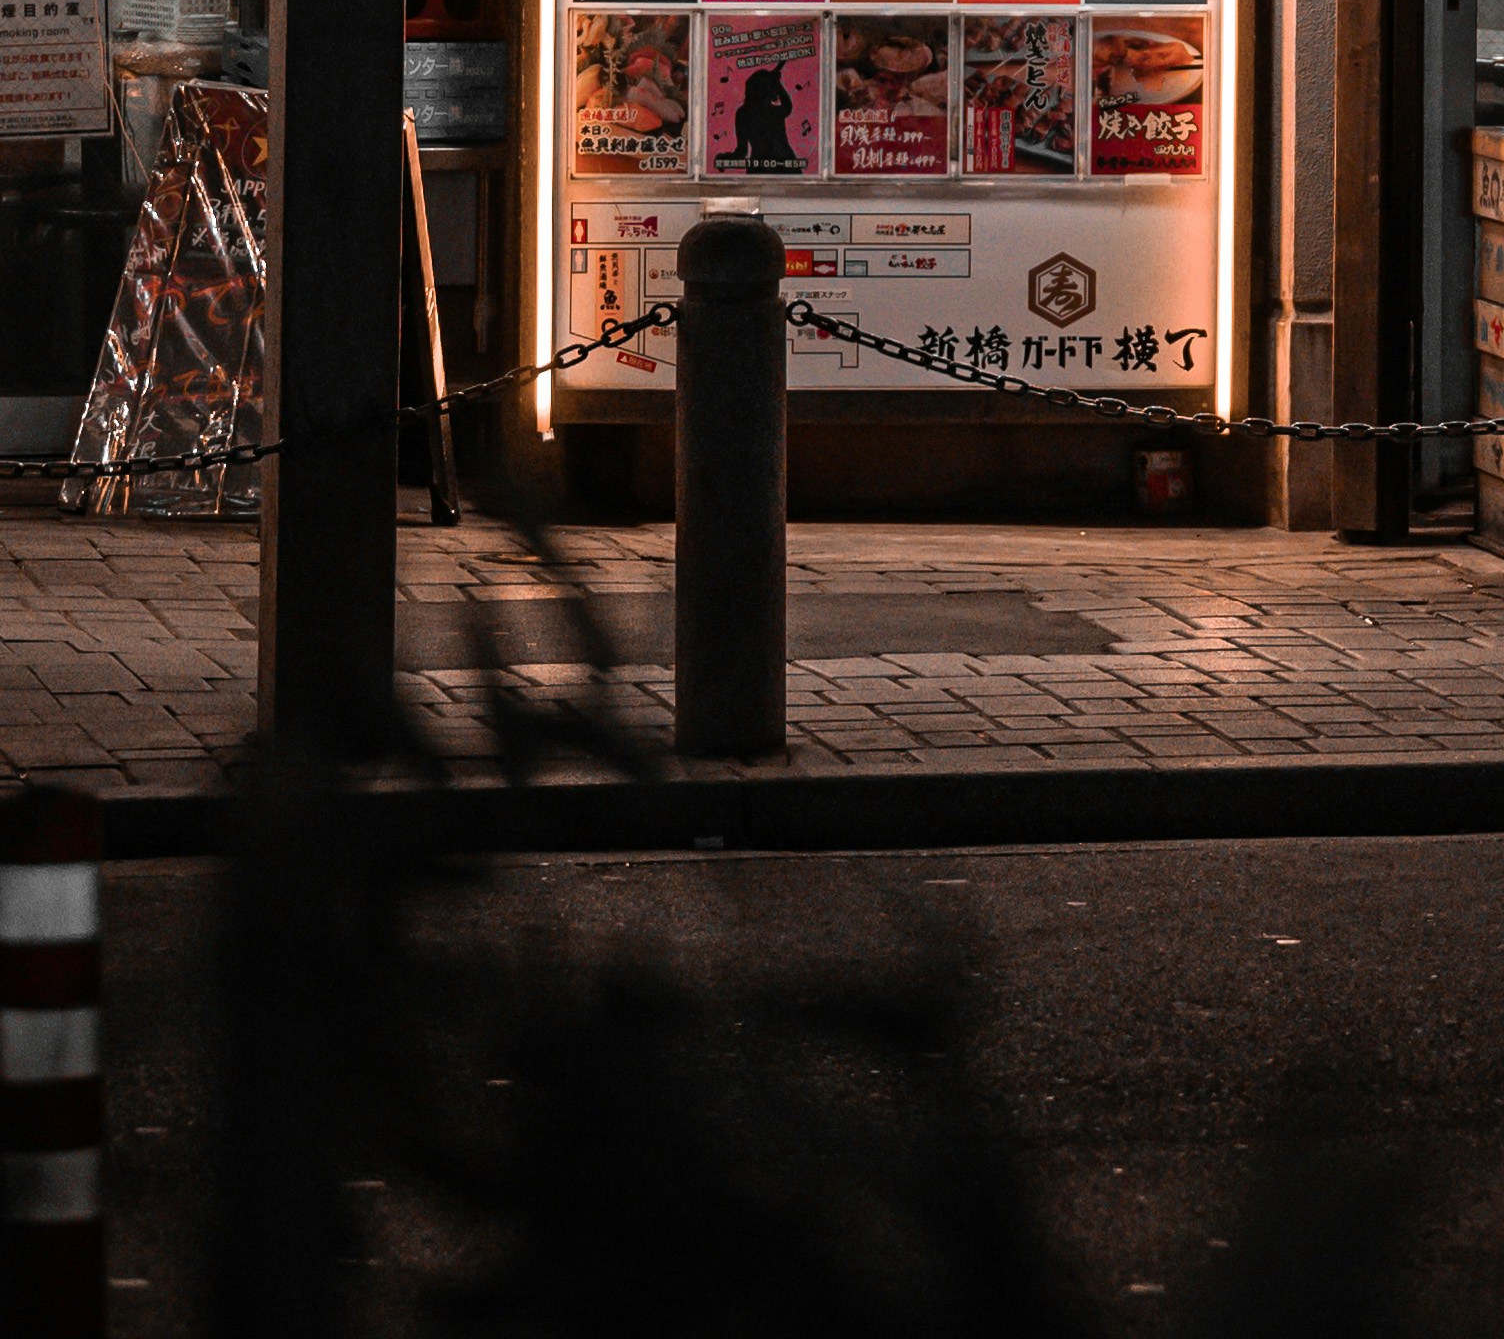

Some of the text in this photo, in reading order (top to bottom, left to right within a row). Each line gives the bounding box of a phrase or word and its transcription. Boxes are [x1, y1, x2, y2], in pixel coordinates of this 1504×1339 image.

[42, 25, 70, 36] room
[1025, 22, 1047, 110] 焼きとん
[1098, 110, 1198, 141] 焼き餃子
[915, 324, 1208, 373] 新橋ガード下横丁
